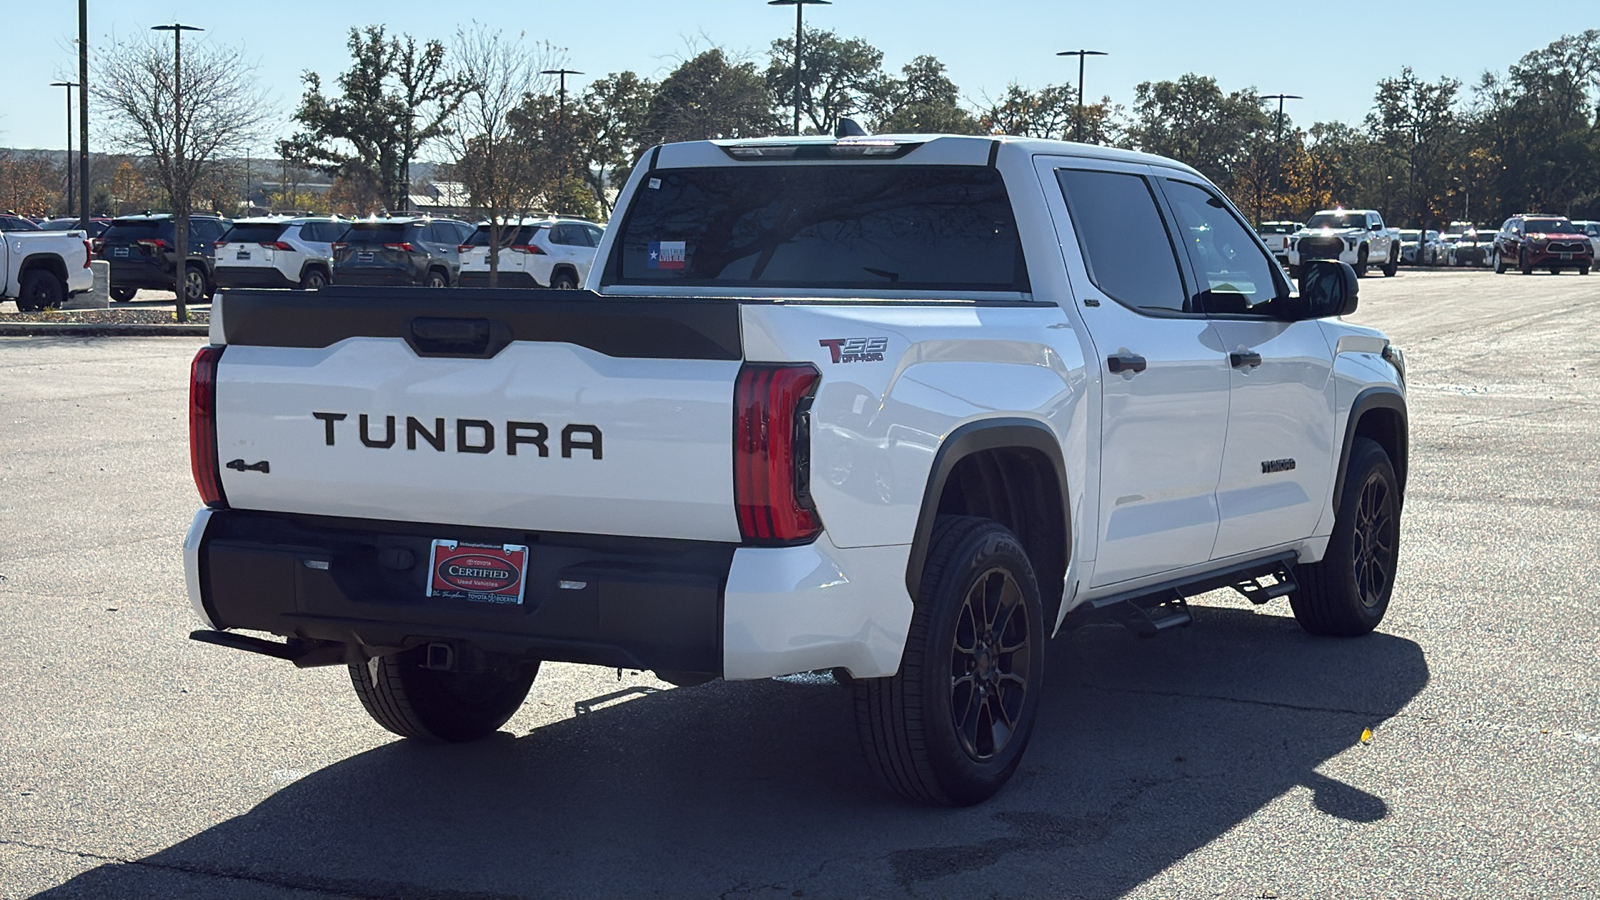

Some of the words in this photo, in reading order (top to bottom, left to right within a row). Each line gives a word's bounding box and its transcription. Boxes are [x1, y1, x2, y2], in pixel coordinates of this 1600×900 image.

[312, 411, 603, 460] TUNDRA
[1261, 457, 1296, 473] TUNDRA
[448, 565, 509, 579] CERTIFIED
[474, 580, 498, 588] Vehicles
